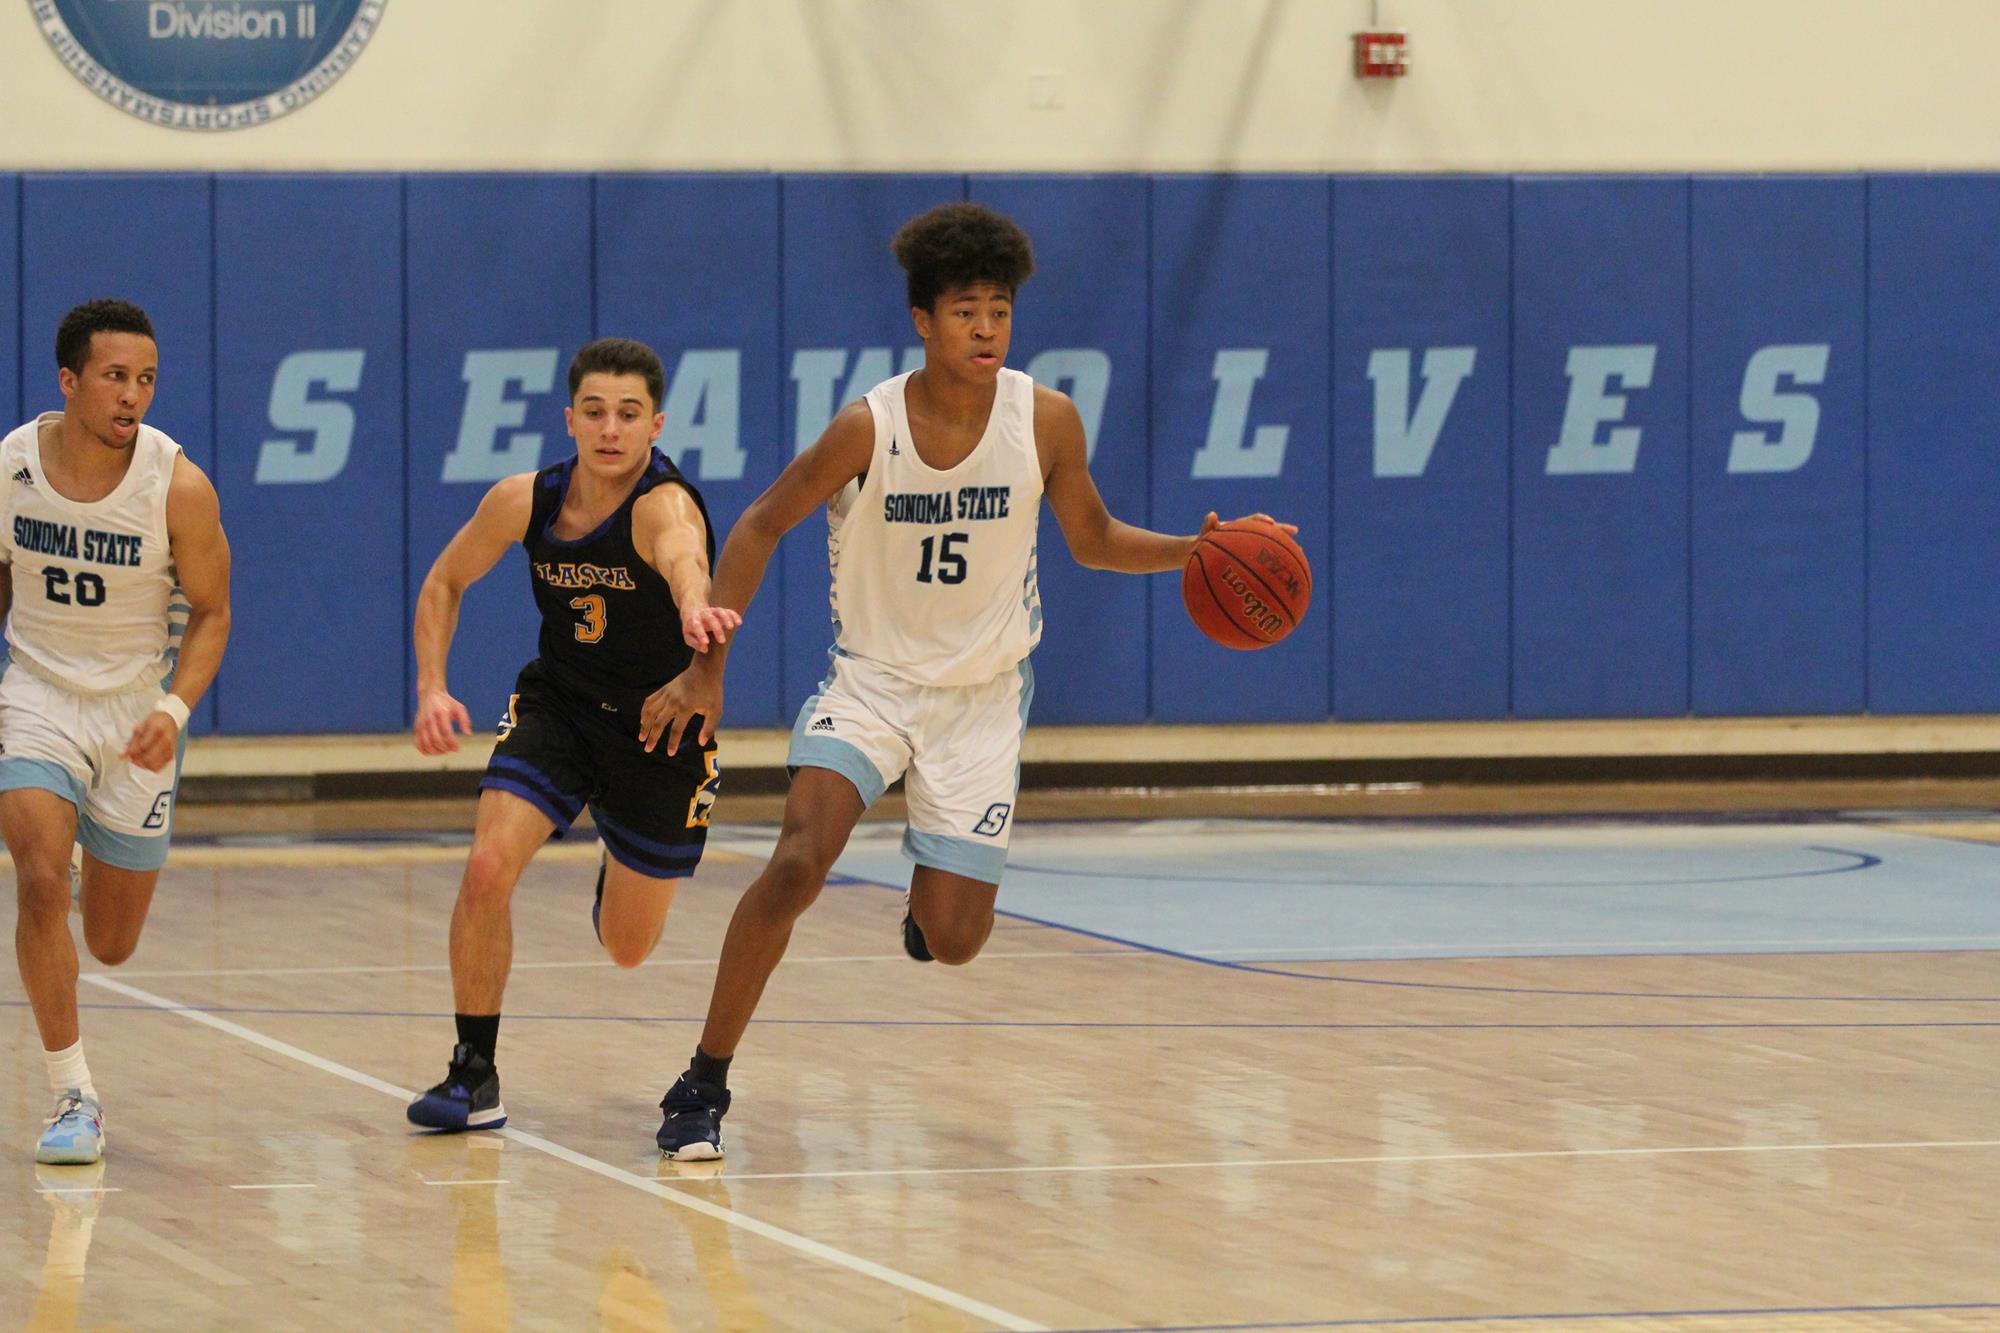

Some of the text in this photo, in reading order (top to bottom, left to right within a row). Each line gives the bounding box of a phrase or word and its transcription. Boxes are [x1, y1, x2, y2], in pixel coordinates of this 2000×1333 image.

[148, 2, 316, 39] Division II
[50, 31, 271, 129] SPORTSMANSHIP
[884, 485, 1011, 524] SONOMA STATE
[13, 515, 142, 567] SONOMA STATE
[916, 532, 969, 585] 15
[42, 565, 106, 607] 20
[533, 562, 637, 591] LASKA
[1221, 565, 1284, 636] Wilson
[569, 594, 608, 645] 3
